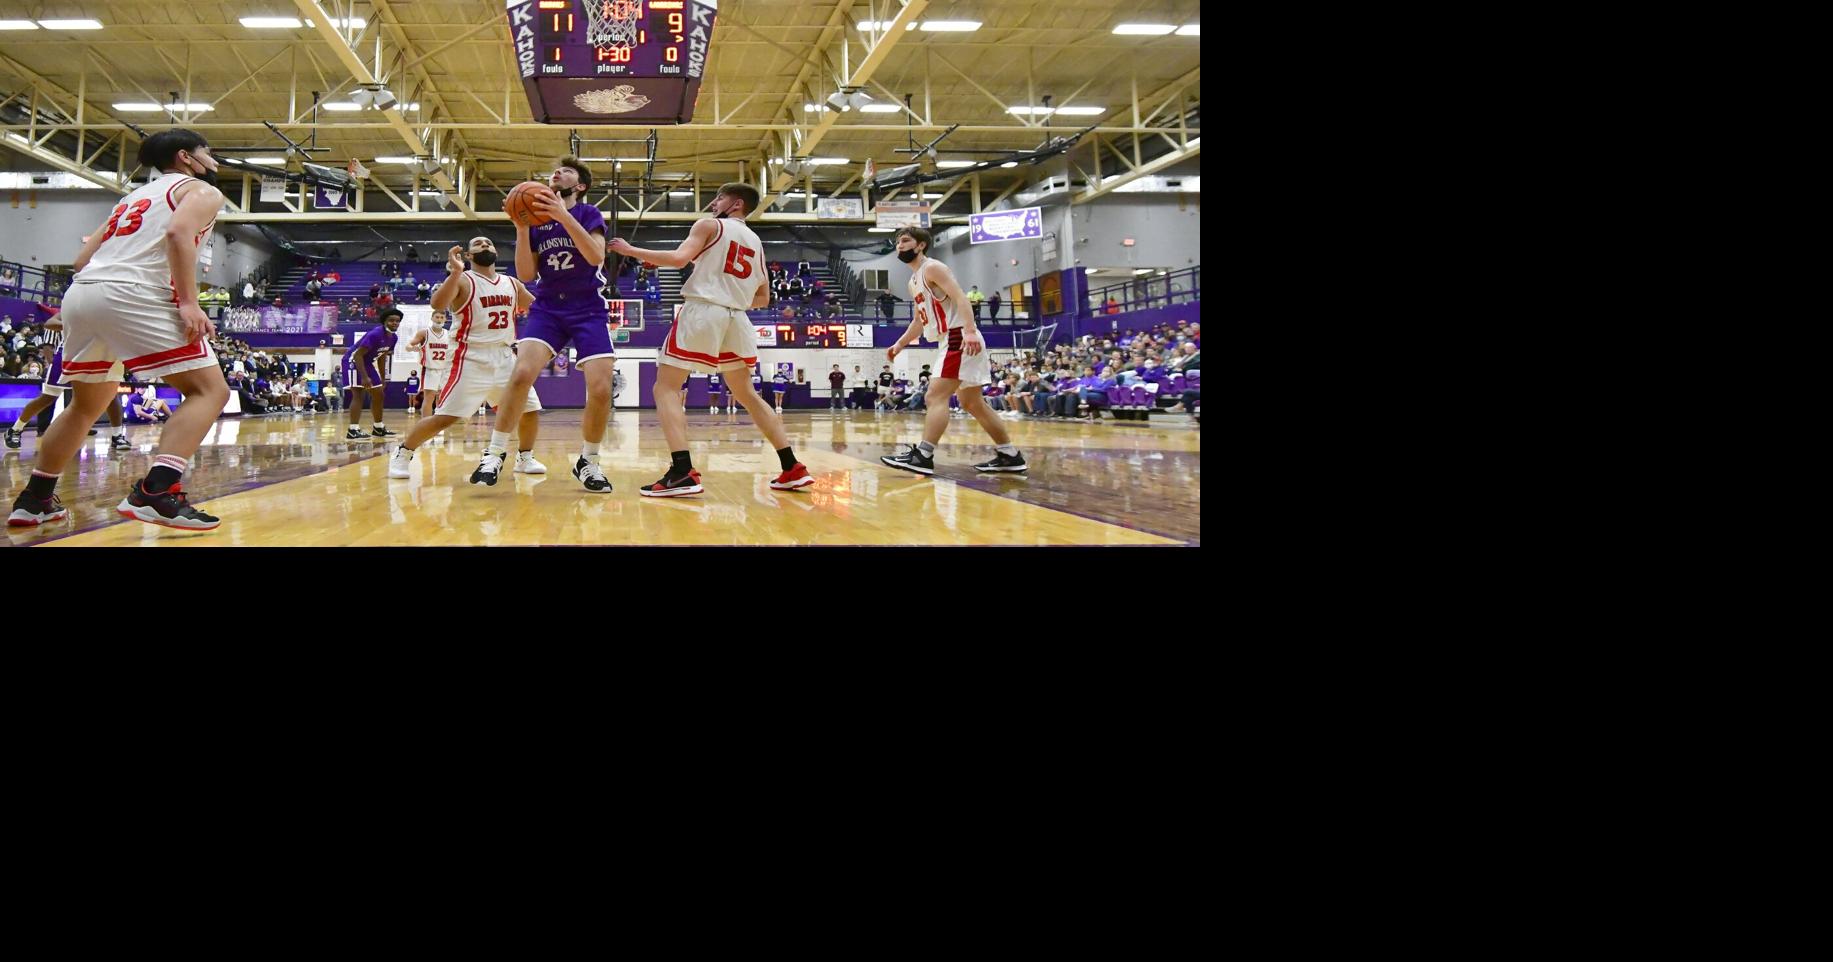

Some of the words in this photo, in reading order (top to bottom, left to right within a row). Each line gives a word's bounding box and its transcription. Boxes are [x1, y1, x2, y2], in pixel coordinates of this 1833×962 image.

[554, 13, 573, 32] 11
[668, 13, 683, 33] 9
[512, 3, 535, 78] KAHOKS
[640, 30, 645, 44] 1
[687, 3, 713, 78] KAHOKS
[555, 48, 560, 61] 1
[666, 47, 678, 62] 0
[542, 64, 563, 73] fouls
[597, 64, 626, 73] player
[660, 64, 680, 74] fouls
[102, 199, 152, 242] 33
[1027, 218, 1039, 228] 61
[972, 224, 982, 235] 19
[546, 251, 575, 271] 42
[724, 240, 755, 279] 15
[488, 310, 508, 330] 23
[784, 331, 795, 341] 11
[807, 325, 827, 336] 1:04
[838, 331, 845, 342] 9
[432, 350, 446, 361] 22
